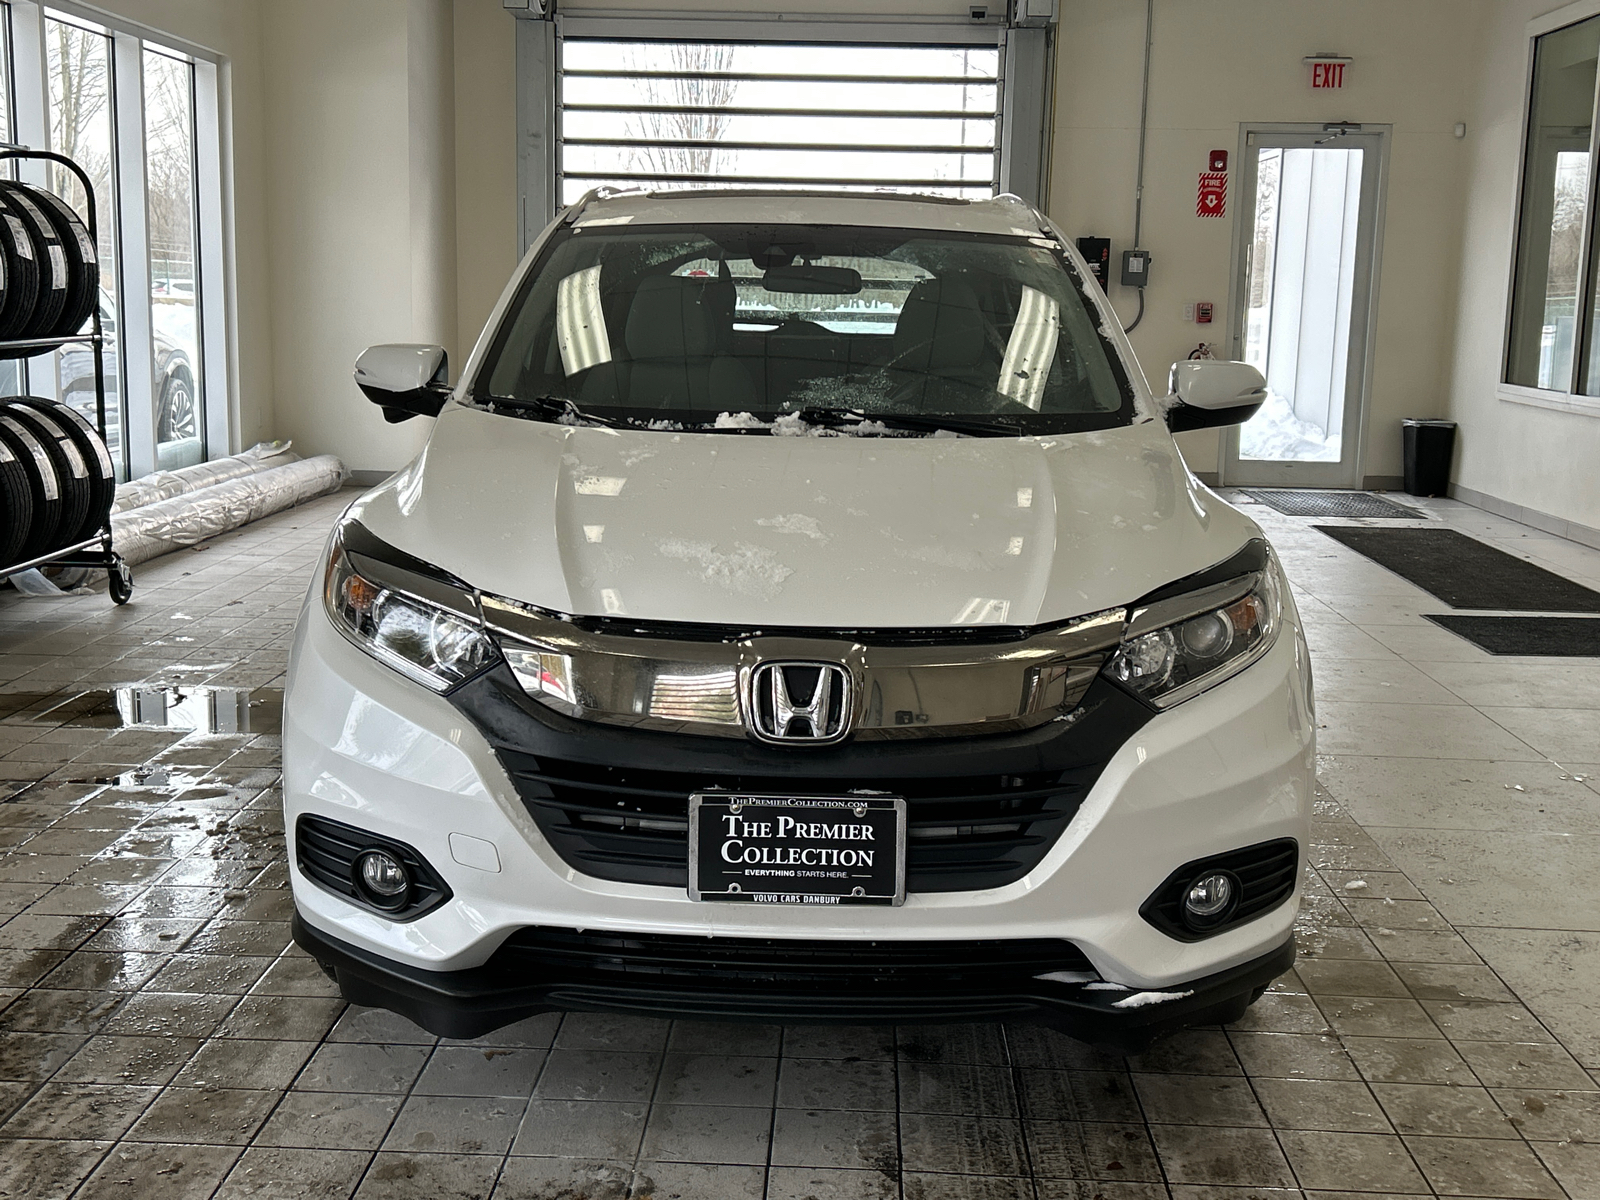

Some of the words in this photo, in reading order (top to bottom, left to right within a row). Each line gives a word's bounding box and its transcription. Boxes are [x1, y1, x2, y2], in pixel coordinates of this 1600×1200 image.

[1312, 63, 1346, 88] EXIT
[721, 814, 772, 838] THE
[776, 816, 875, 840] PREMIER
[720, 839, 875, 867] COLLECTION
[745, 869, 795, 877] EVERYTHING
[796, 870, 825, 878] STARTS
[753, 894, 778, 903] VOLVO
[781, 895, 801, 903] CARS
[803, 895, 841, 904] DANBURY
